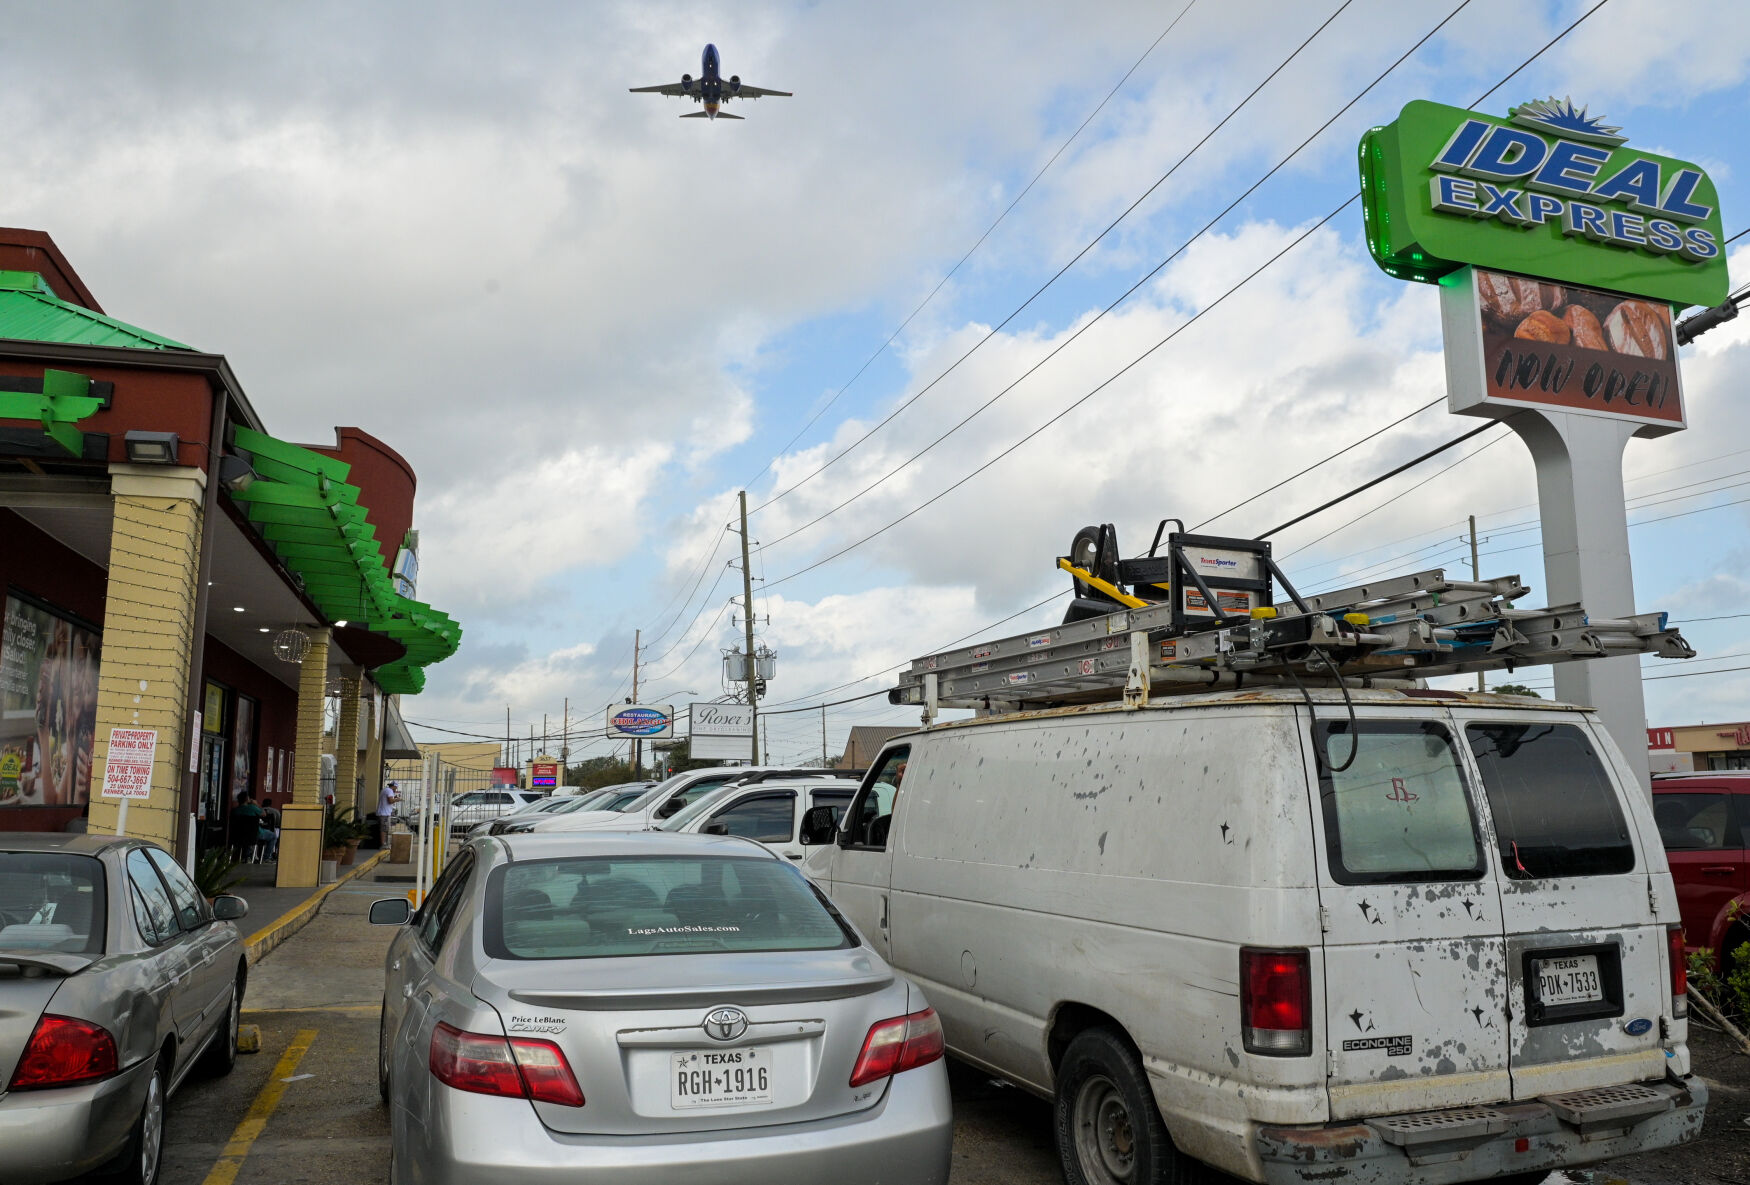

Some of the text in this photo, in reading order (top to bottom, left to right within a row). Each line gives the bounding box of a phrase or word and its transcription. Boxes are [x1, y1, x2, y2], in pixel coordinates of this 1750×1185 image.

[1432, 119, 1713, 222] IDEAL
[1431, 175, 1718, 258] EXPRESS
[1495, 349, 1575, 394] NOW
[11, 611, 37, 636] bringing
[16, 632, 36, 652] closer,
[694, 706, 752, 725] Roser's
[112, 730, 155, 741] PRIVATE PROPERTY
[111, 740, 154, 750] PARKING ONLY
[107, 765, 150, 775] ON TIME TOWING
[627, 925, 740, 935] LagsAutoSales.com
[1553, 960, 1578, 970] TEXAS
[1344, 1036, 1412, 1050] ECONOLINE
[1388, 1046, 1412, 1055] 250
[704, 1053, 742, 1064] TEXAS
